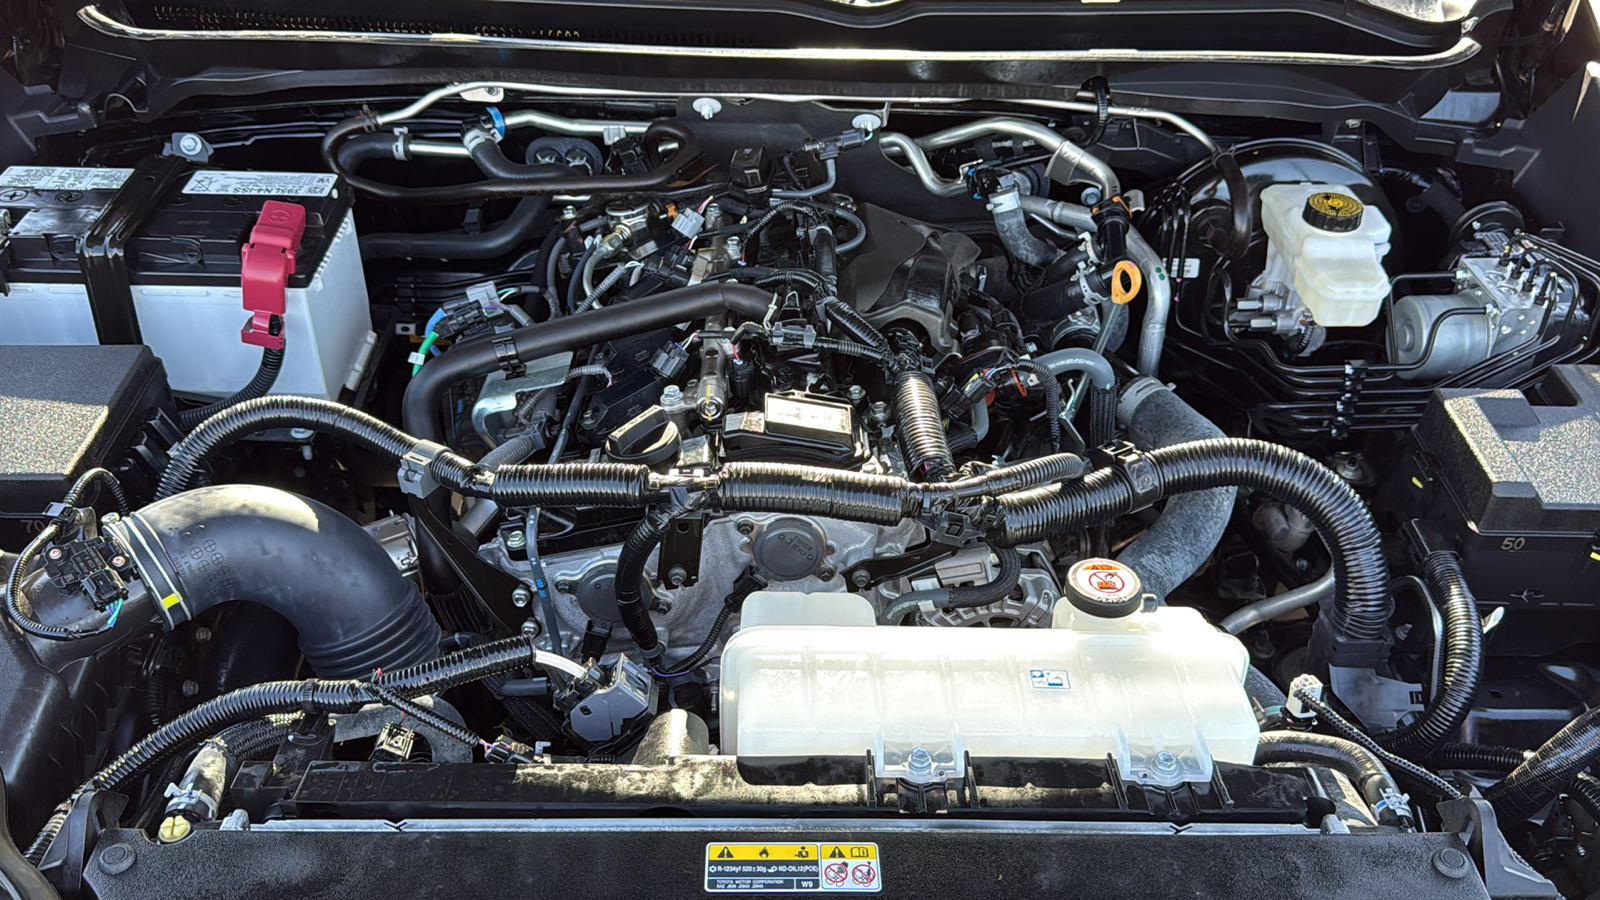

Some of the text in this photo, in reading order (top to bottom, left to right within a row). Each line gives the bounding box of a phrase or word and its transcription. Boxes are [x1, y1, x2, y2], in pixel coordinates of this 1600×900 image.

[1500, 537, 1526, 550] 50
[717, 865, 741, 873] R-1234yf
[801, 880, 814, 888] W9
